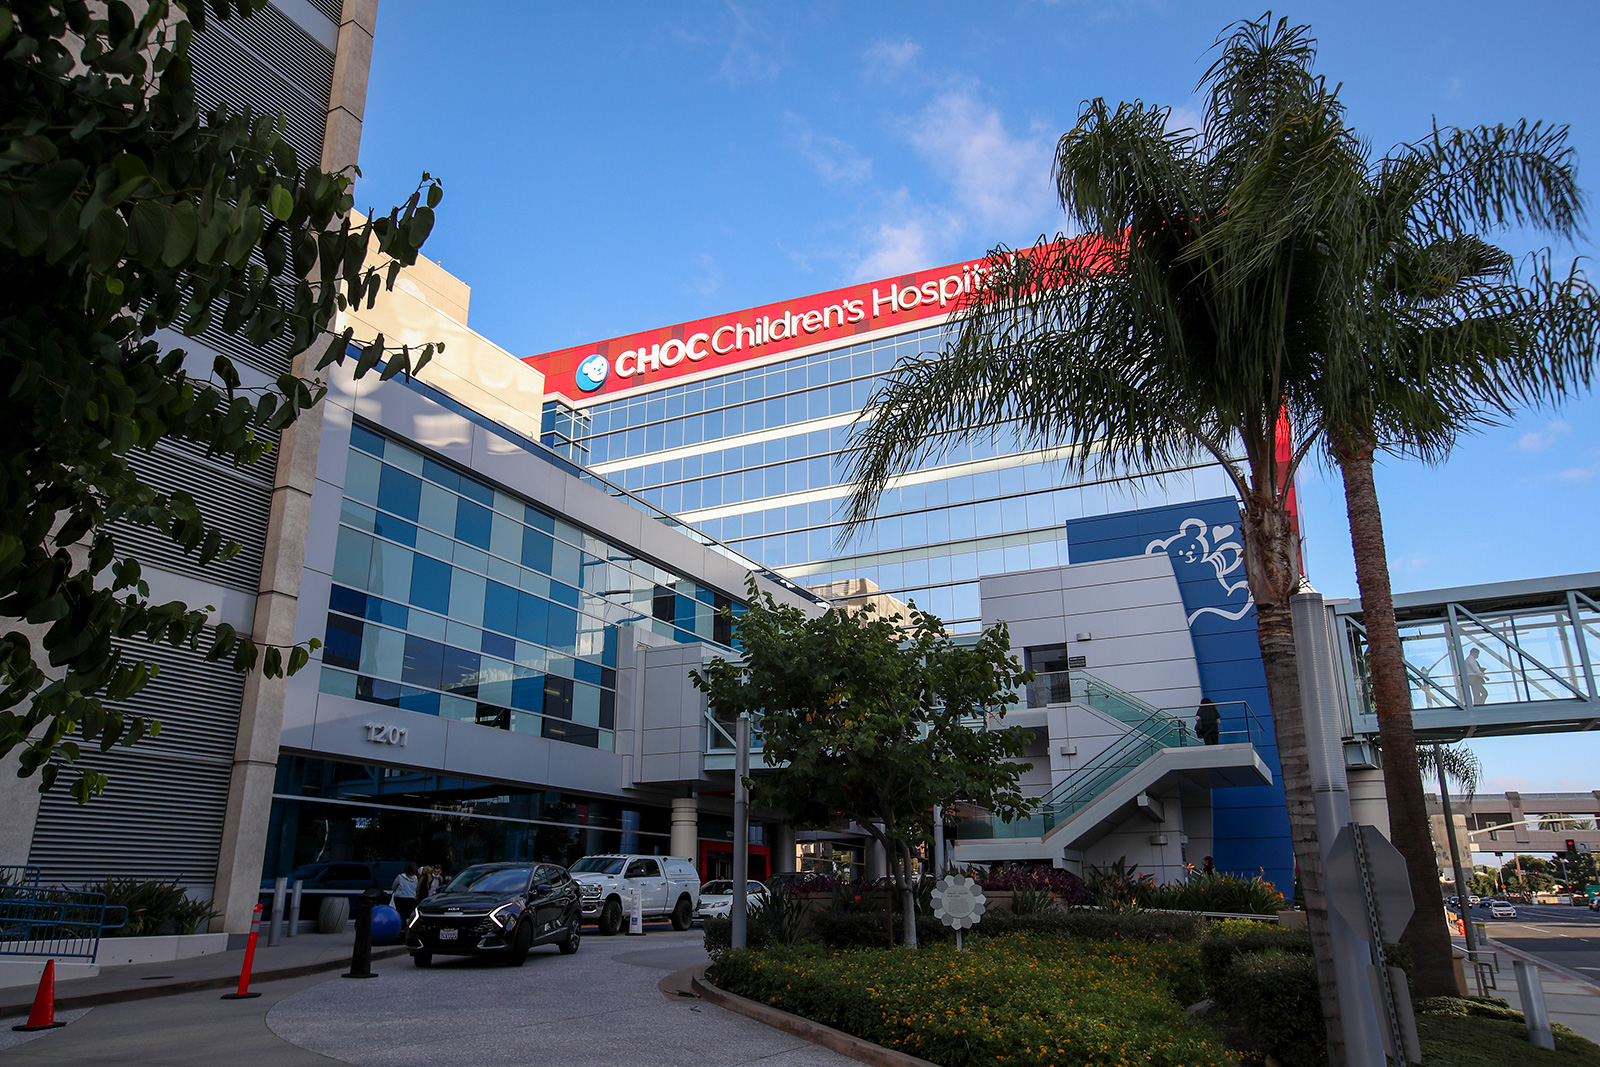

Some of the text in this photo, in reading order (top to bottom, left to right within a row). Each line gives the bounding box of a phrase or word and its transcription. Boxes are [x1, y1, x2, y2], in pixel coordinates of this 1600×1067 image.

[615, 332, 710, 378] CHOC
[711, 298, 864, 355] Children's
[364, 721, 409, 747] 1201
